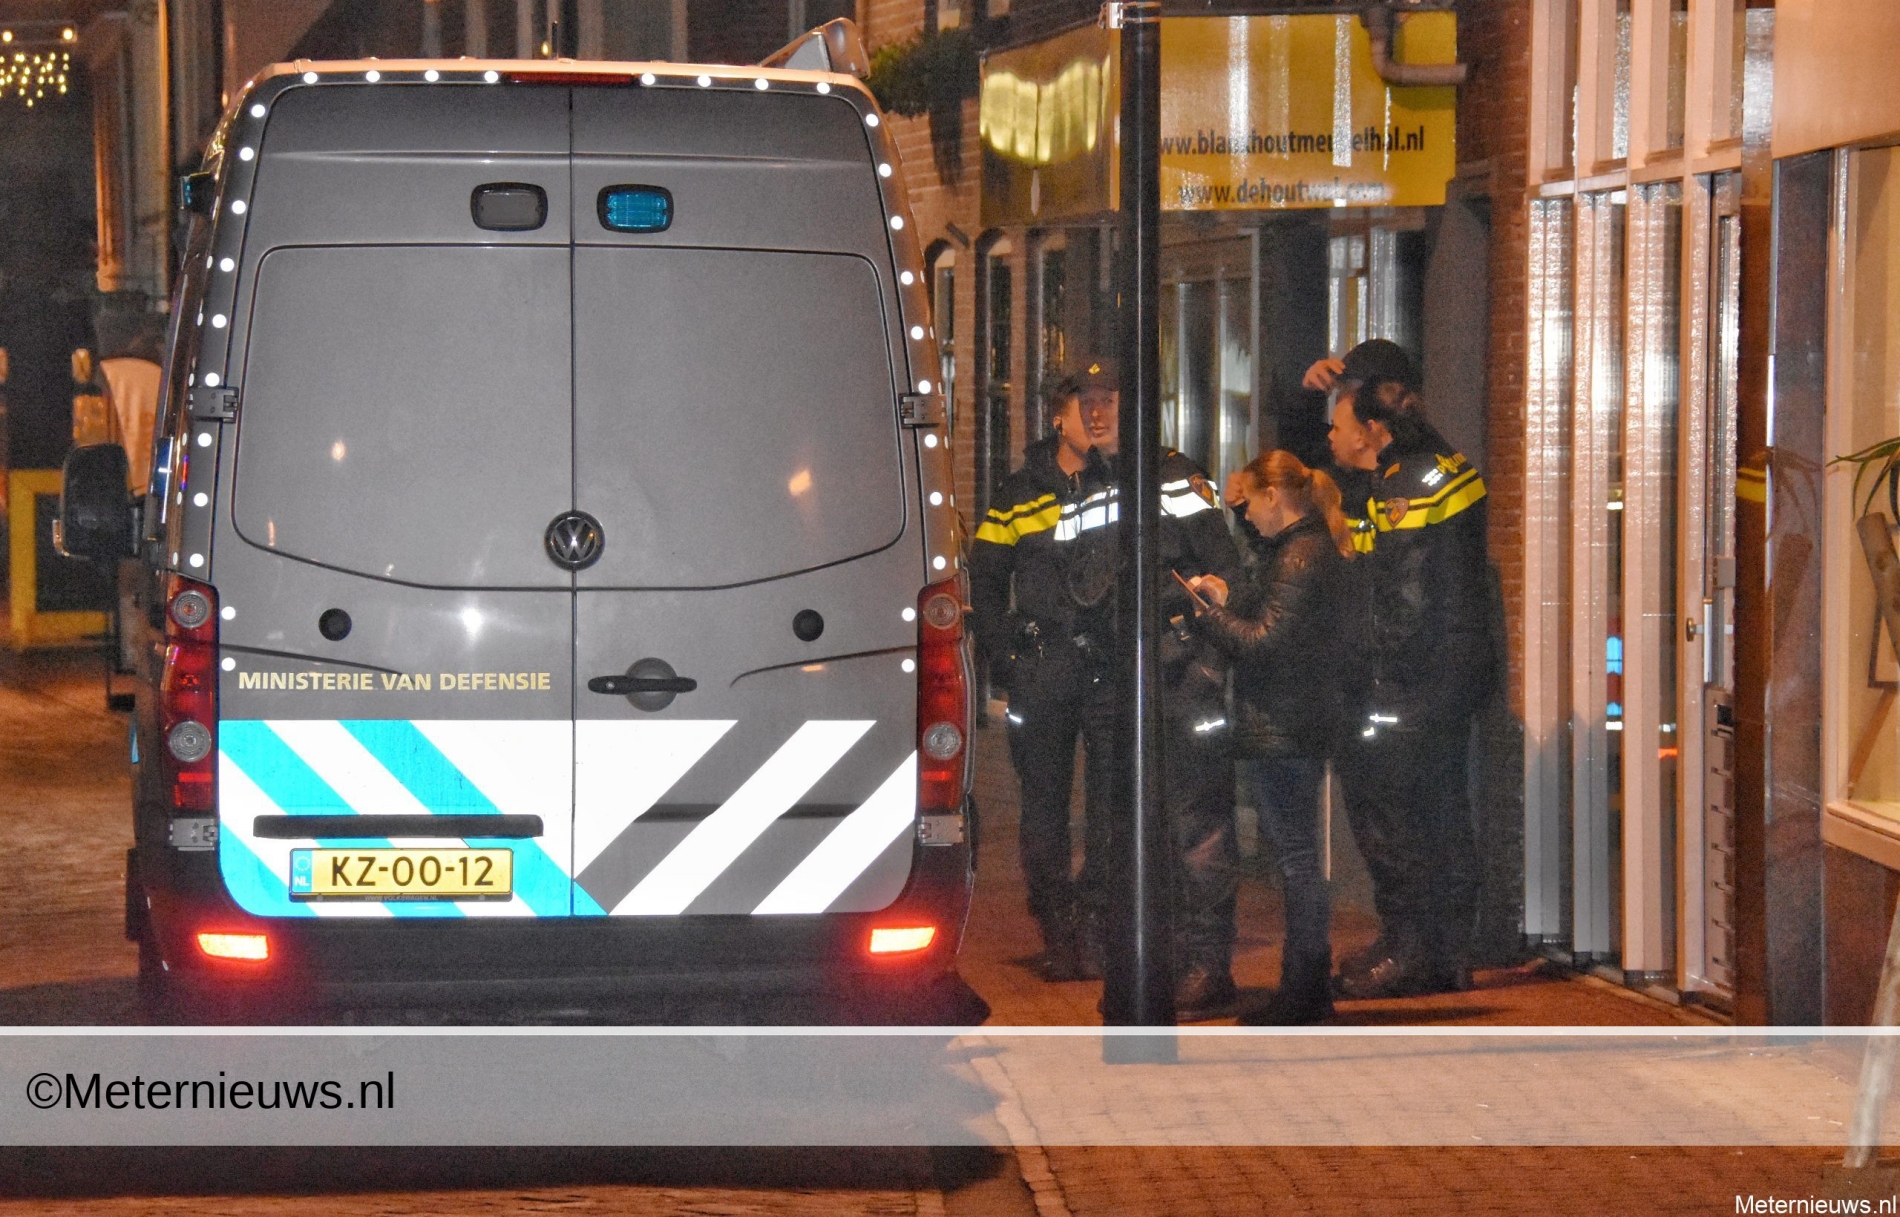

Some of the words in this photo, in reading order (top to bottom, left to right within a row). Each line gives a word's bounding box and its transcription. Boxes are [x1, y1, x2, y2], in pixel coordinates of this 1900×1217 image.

[238, 672, 374, 691] MINISTERIE
[381, 672, 432, 691] VAN
[439, 672, 551, 691] DEFENSIE
[331, 856, 494, 886] KZ-00-12
[294, 876, 310, 887] NL
